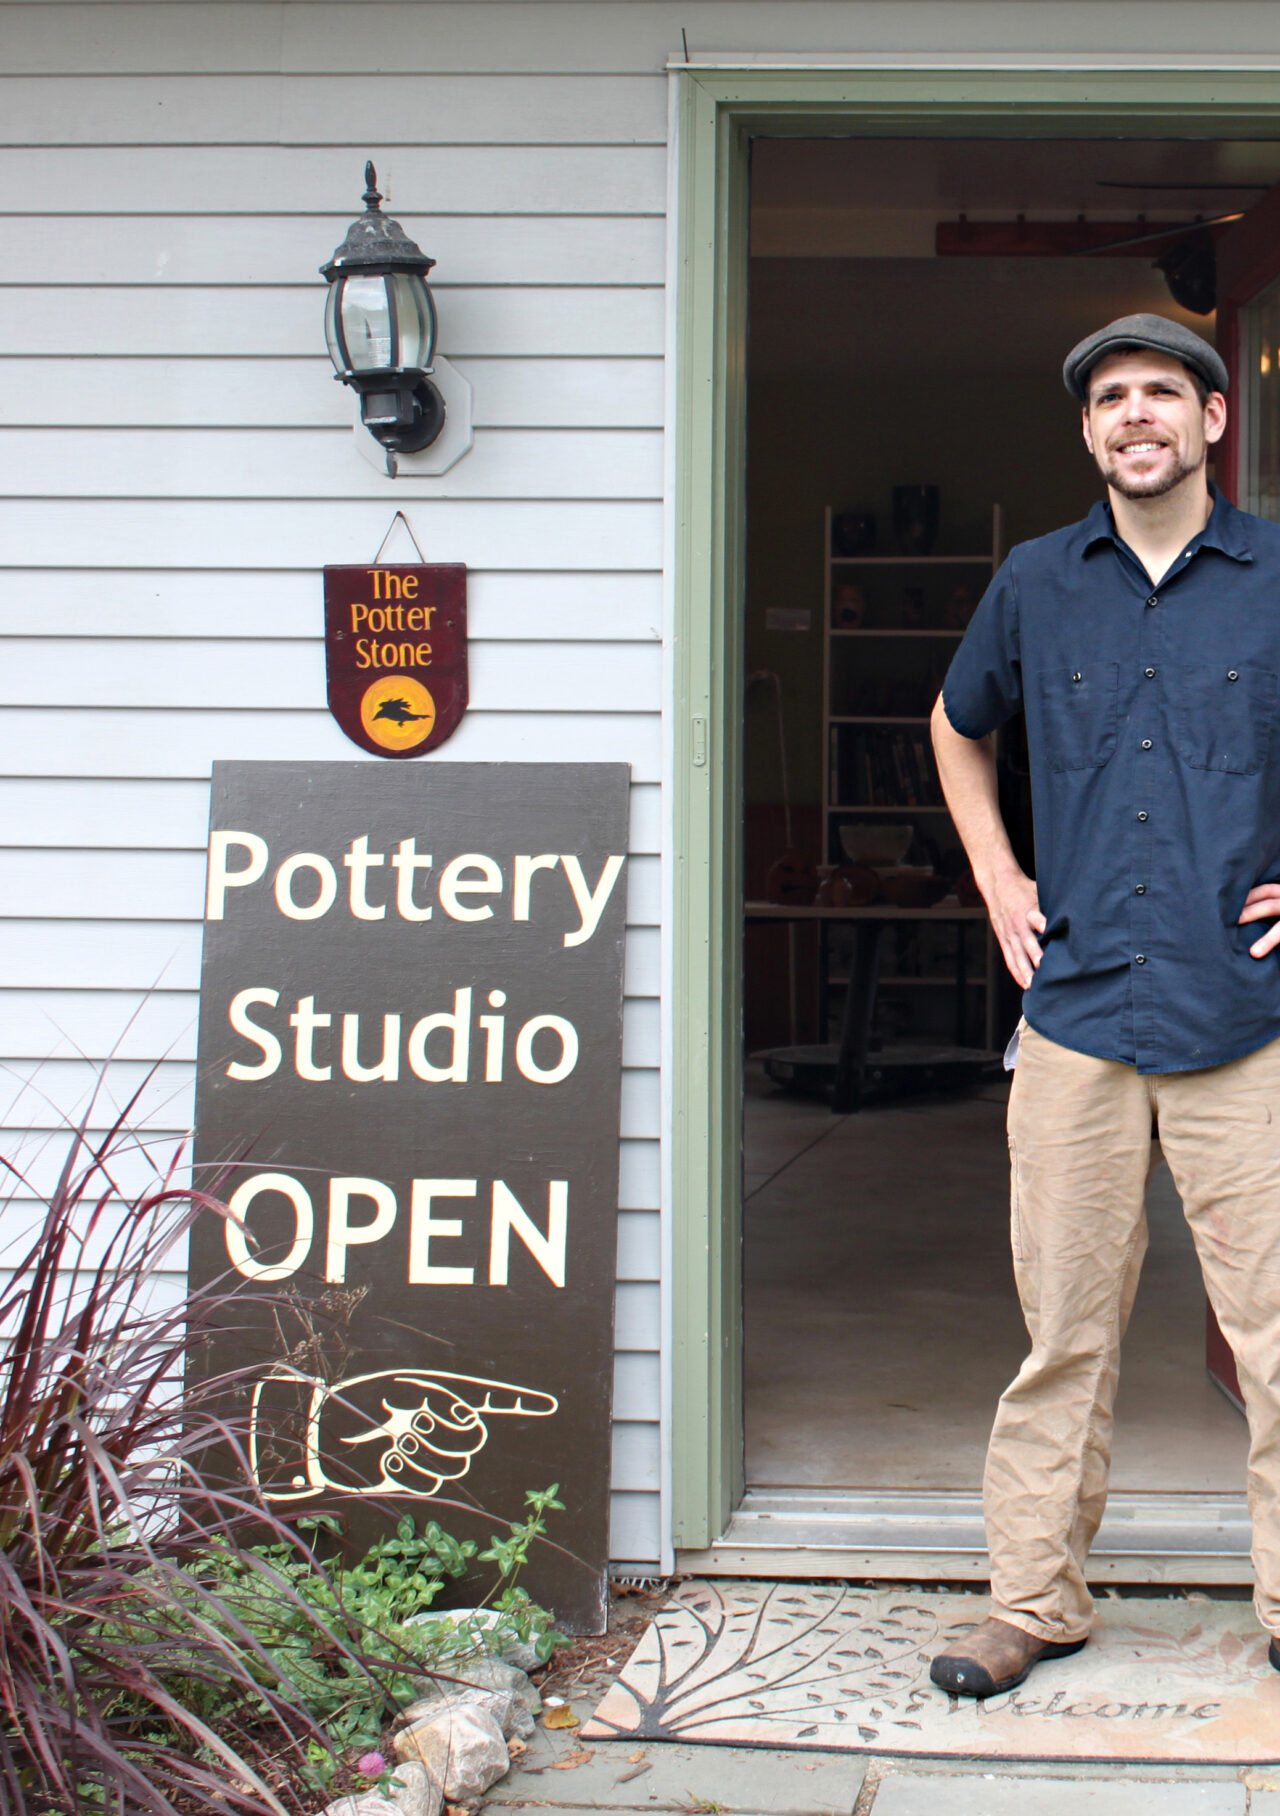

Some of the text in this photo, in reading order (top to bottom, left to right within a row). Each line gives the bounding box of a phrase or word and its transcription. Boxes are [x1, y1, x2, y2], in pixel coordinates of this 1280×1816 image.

[367, 569, 419, 600] The
[350, 603, 437, 634] Potter
[355, 638, 433, 669] Stone
[205, 830, 628, 948] Pottery
[225, 986, 579, 1085] Studio
[224, 1172, 569, 1289] OPEN
